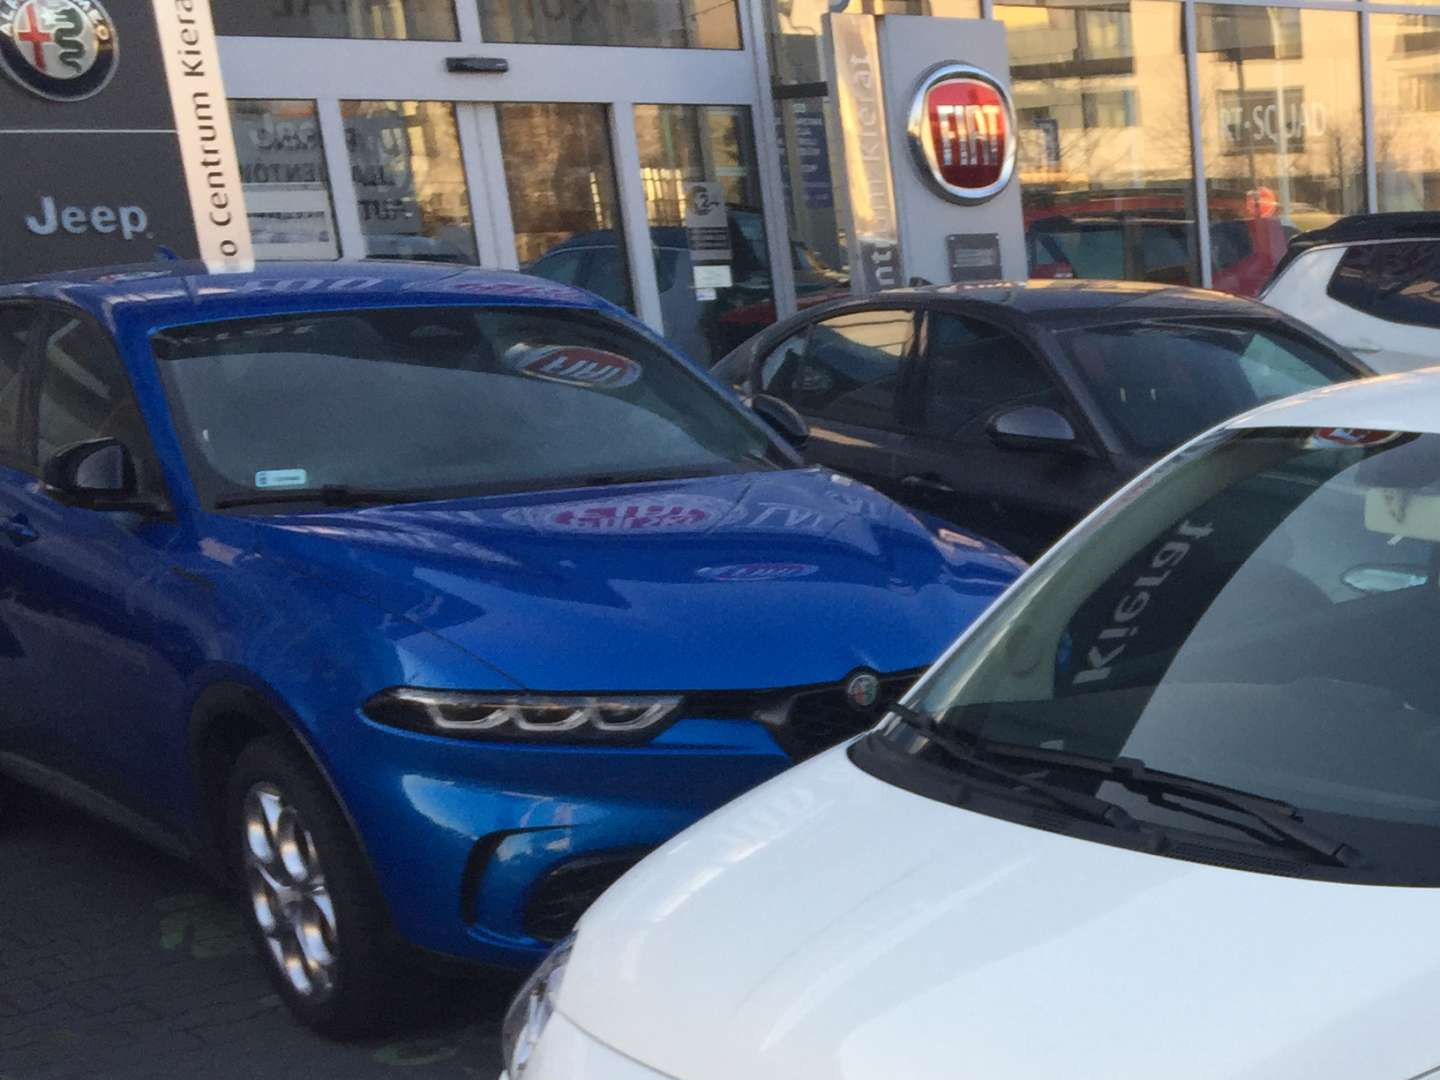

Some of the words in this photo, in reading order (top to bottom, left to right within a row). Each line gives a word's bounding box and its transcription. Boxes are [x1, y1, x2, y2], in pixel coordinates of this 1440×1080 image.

[193, 92, 232, 227] Centrum
[936, 104, 999, 166] FIAT
[24, 195, 149, 240] Jeep
